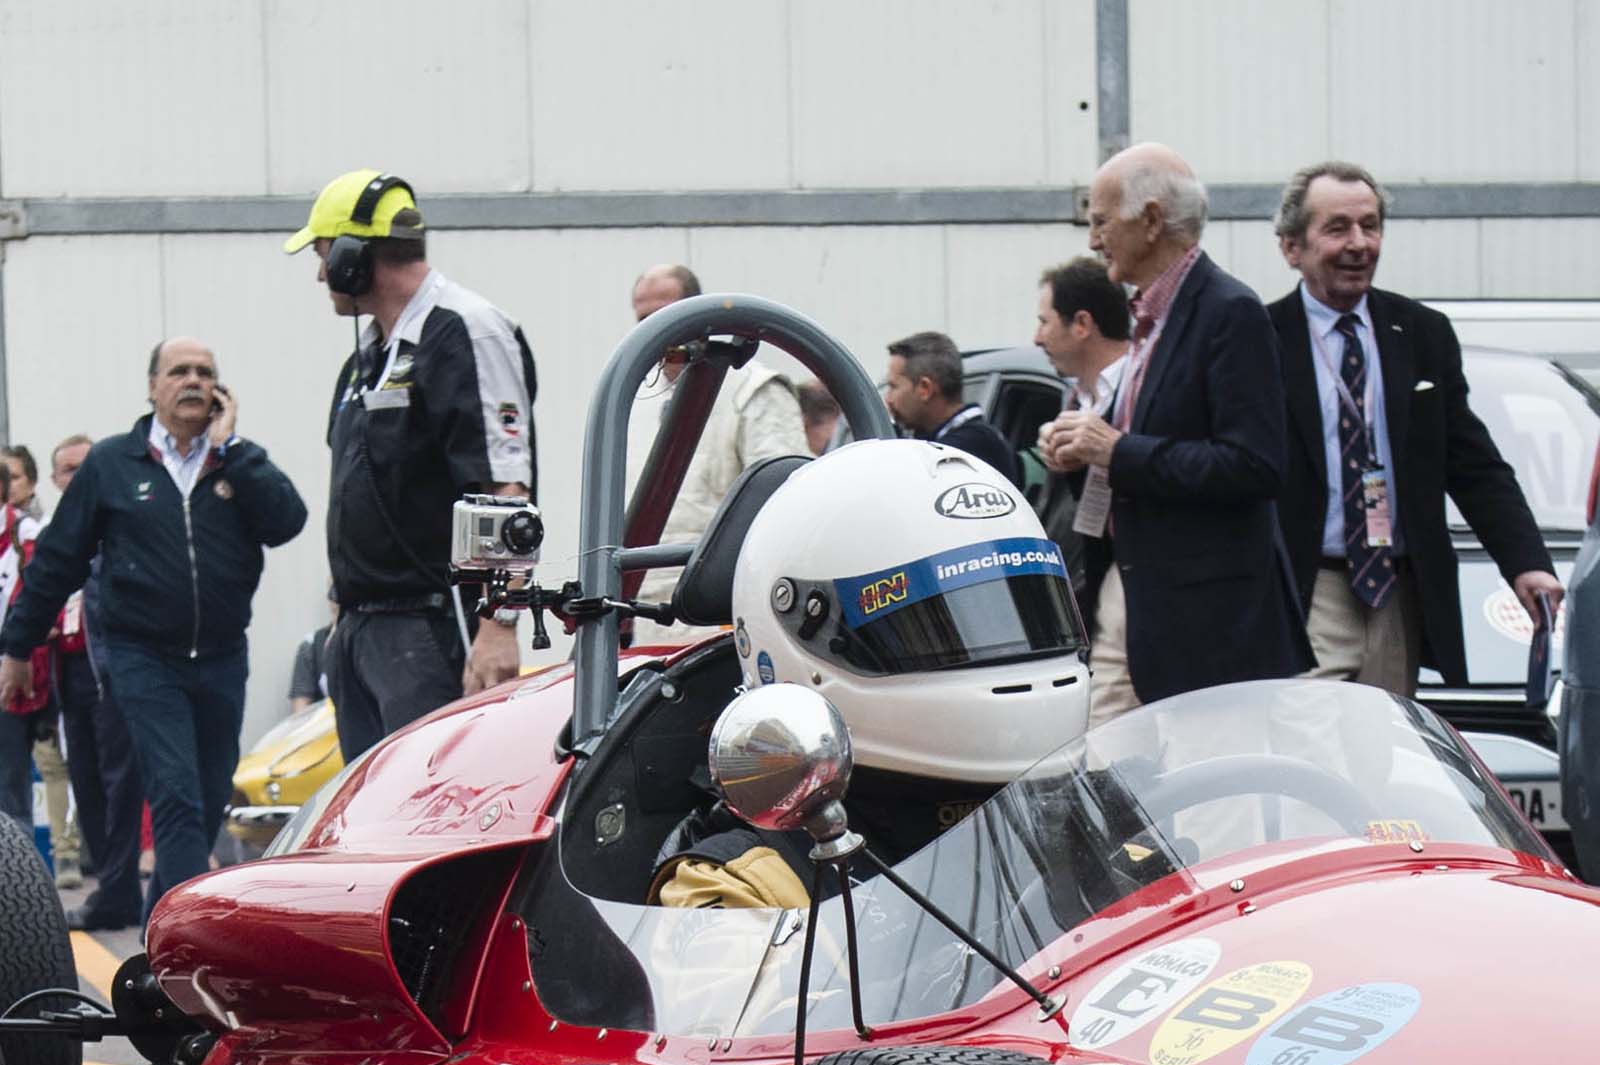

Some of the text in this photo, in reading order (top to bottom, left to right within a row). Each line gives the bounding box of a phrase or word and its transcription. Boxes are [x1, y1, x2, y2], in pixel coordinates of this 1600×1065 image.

[946, 487, 1008, 514] Arai
[937, 551, 1060, 580] inracing.co.uk
[1140, 952, 1209, 977] MONACO
[1089, 967, 1177, 1019] E
[1173, 987, 1277, 1031] B
[1079, 1017, 1117, 1044] 40
[1271, 1005, 1385, 1051] B
